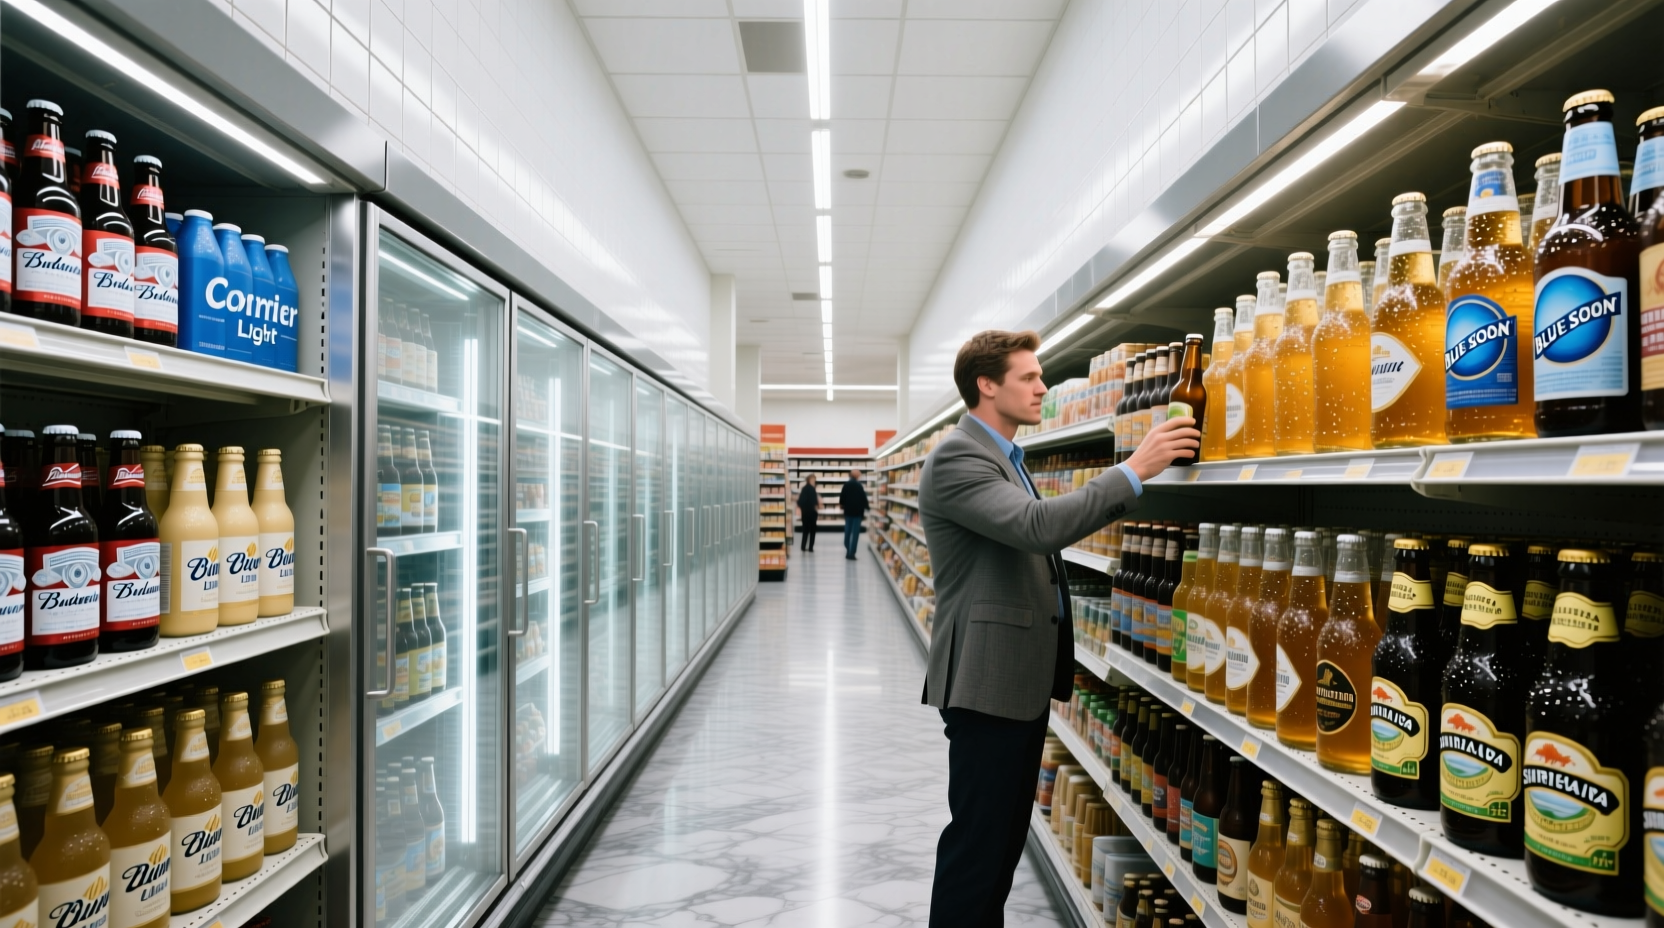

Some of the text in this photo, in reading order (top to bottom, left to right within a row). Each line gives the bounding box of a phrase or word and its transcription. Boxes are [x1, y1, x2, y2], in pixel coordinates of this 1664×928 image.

[1468, 320, 1511, 350] SOON
[1534, 318, 1568, 355] BLUE
[1568, 296, 1617, 330] SOON
